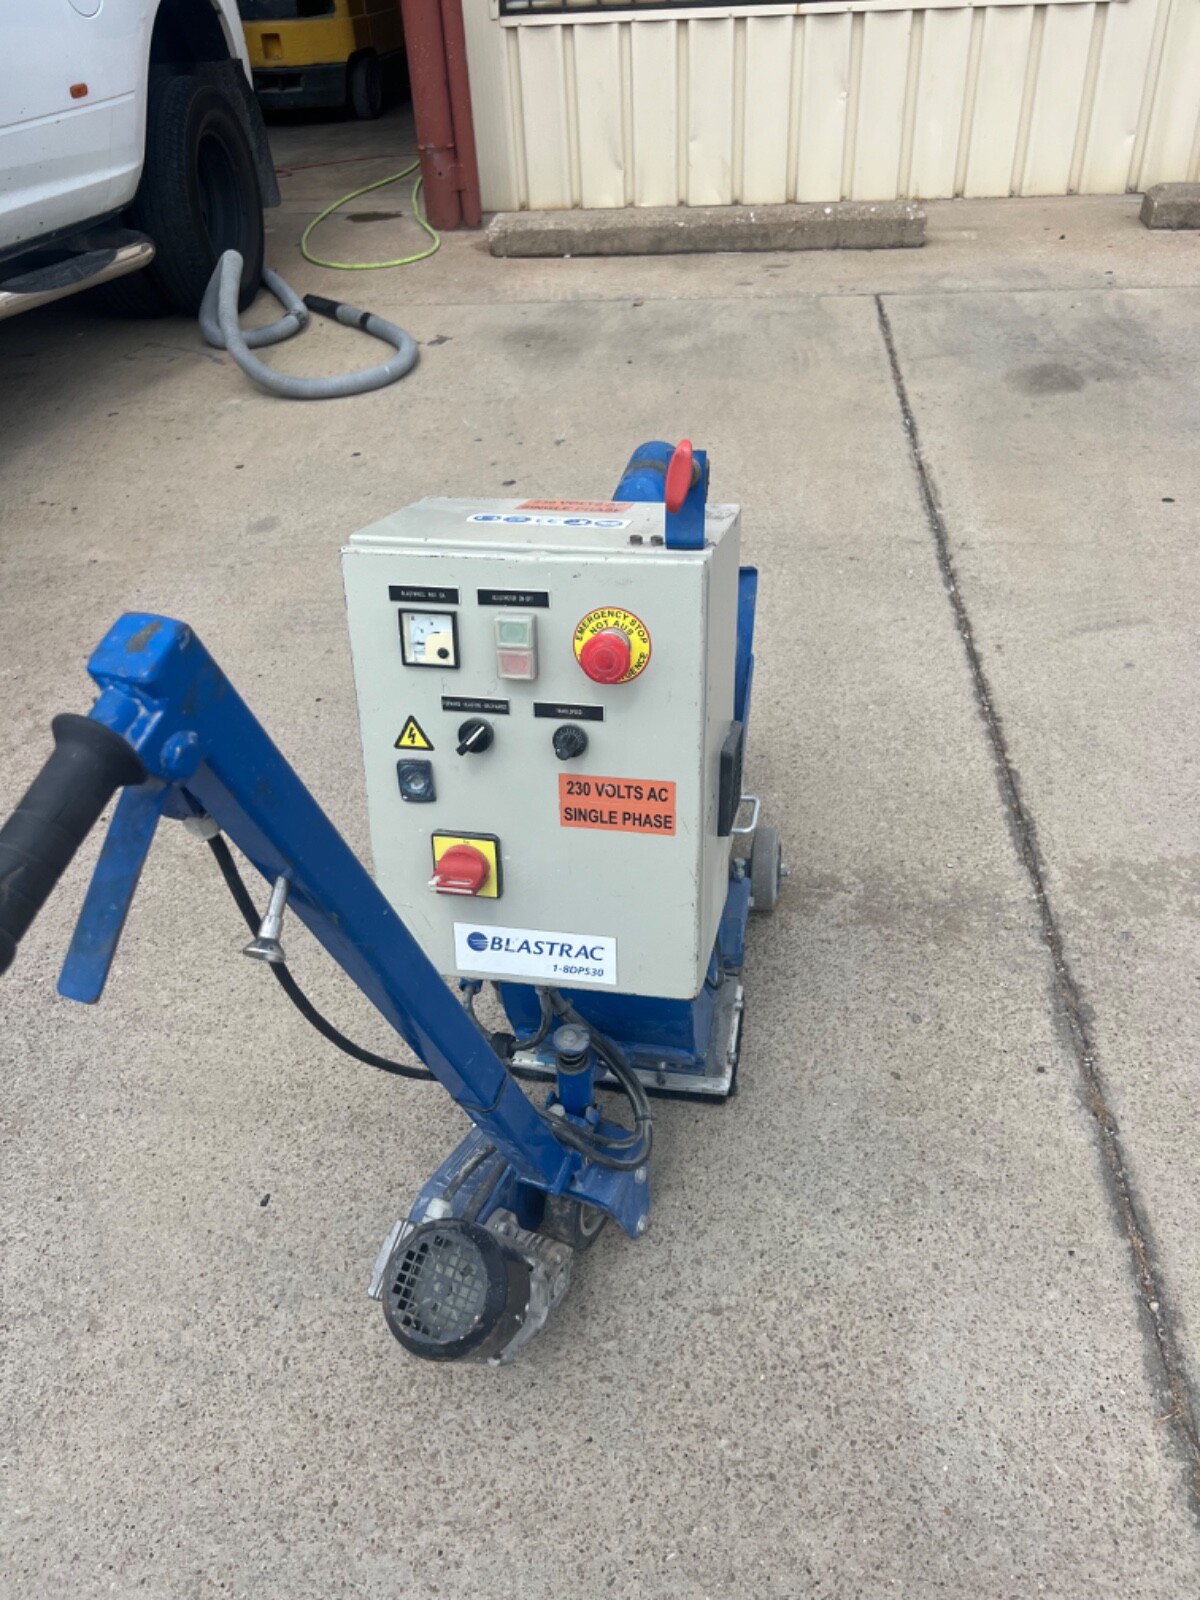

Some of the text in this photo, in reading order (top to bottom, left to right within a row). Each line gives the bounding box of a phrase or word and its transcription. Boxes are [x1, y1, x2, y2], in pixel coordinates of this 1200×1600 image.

[576, 610, 648, 643] EMERGENCY STOP
[589, 619, 609, 635] NOT
[566, 780, 669, 802] 230 VOLTS AC
[564, 807, 673, 830] SINGLE PHASE
[490, 936, 605, 961] BLASTRAC
